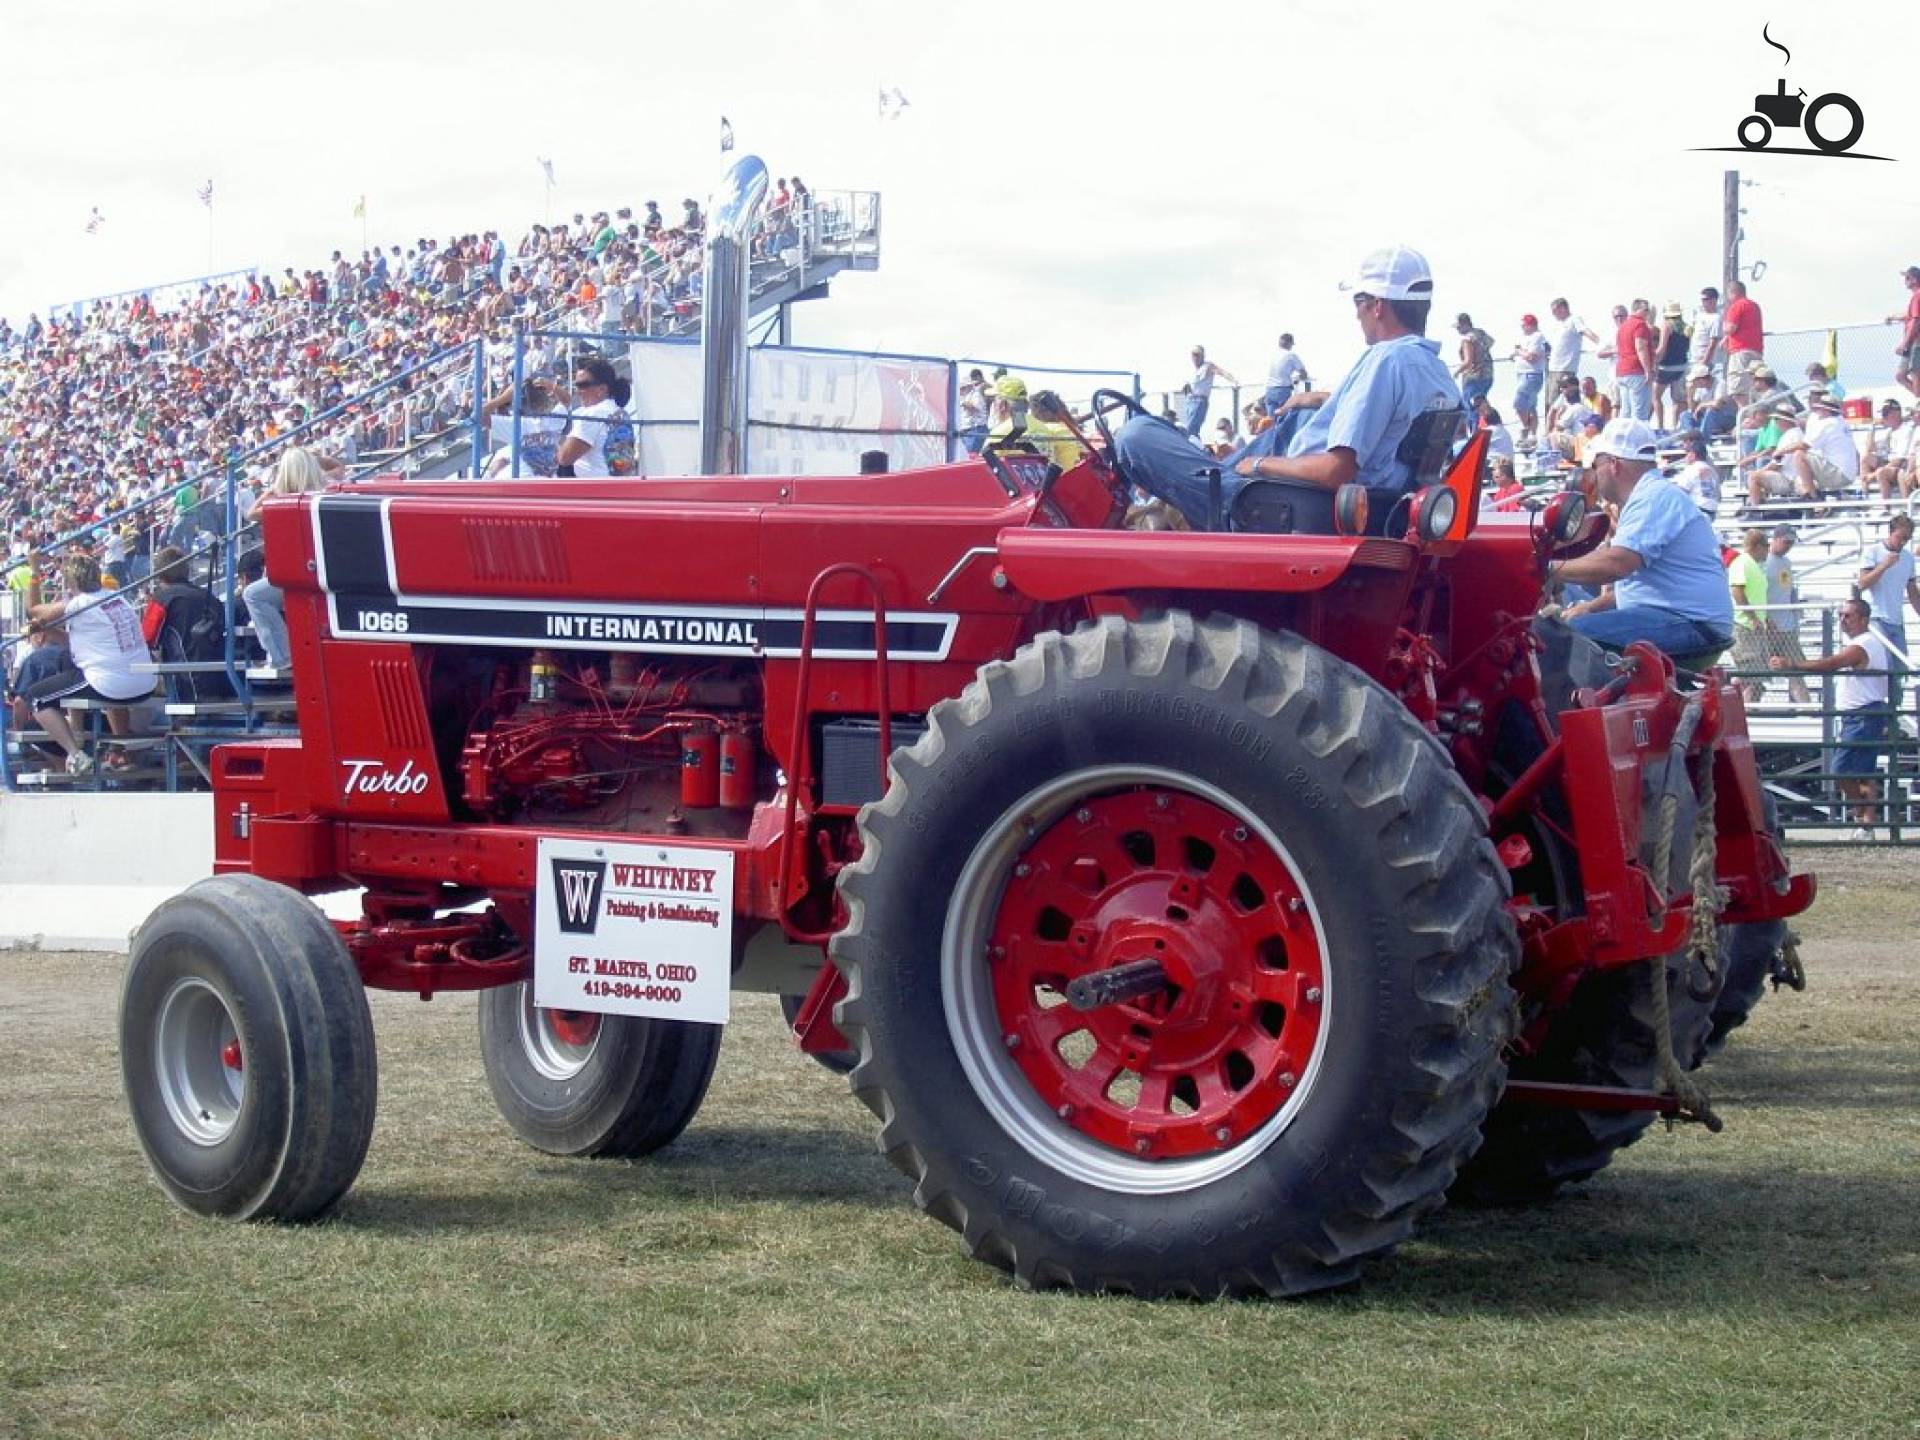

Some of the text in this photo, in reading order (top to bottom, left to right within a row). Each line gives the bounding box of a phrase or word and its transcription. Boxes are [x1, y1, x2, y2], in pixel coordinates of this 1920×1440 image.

[358, 610, 408, 633] 1066
[546, 616, 759, 644] INTERNATIONAL
[342, 760, 429, 794] Turbo
[613, 864, 716, 893] WHITNEY
[560, 870, 598, 924] W
[607, 899, 720, 928] Painting & Sandblasting
[568, 955, 590, 974] ST.
[656, 963, 697, 983] OHIO
[583, 980, 681, 1002] 419-394-9000
